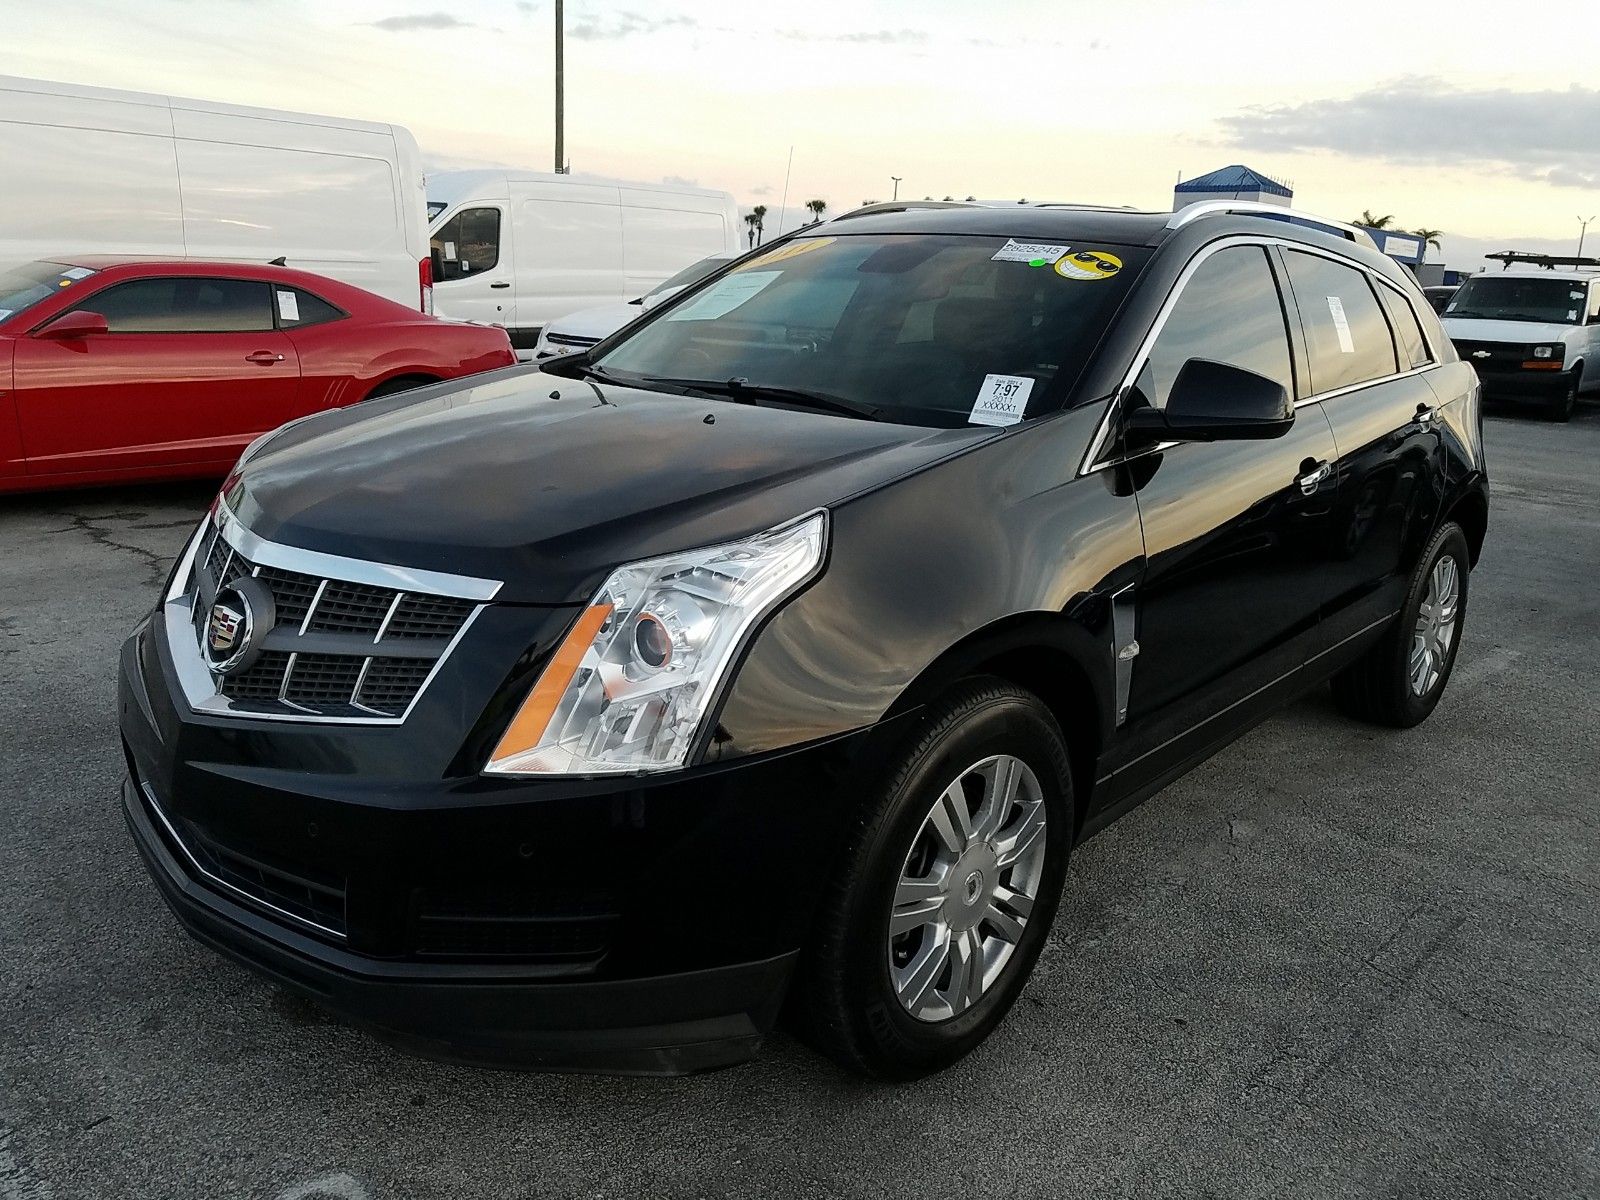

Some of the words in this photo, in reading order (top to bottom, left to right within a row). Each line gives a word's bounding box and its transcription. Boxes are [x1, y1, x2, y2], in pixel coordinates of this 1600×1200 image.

[1003, 243, 1062, 255] 2825245
[992, 383, 1020, 397] 7:97
[991, 395, 1013, 403] 2011
[980, 400, 1016, 412] XXXXX1
